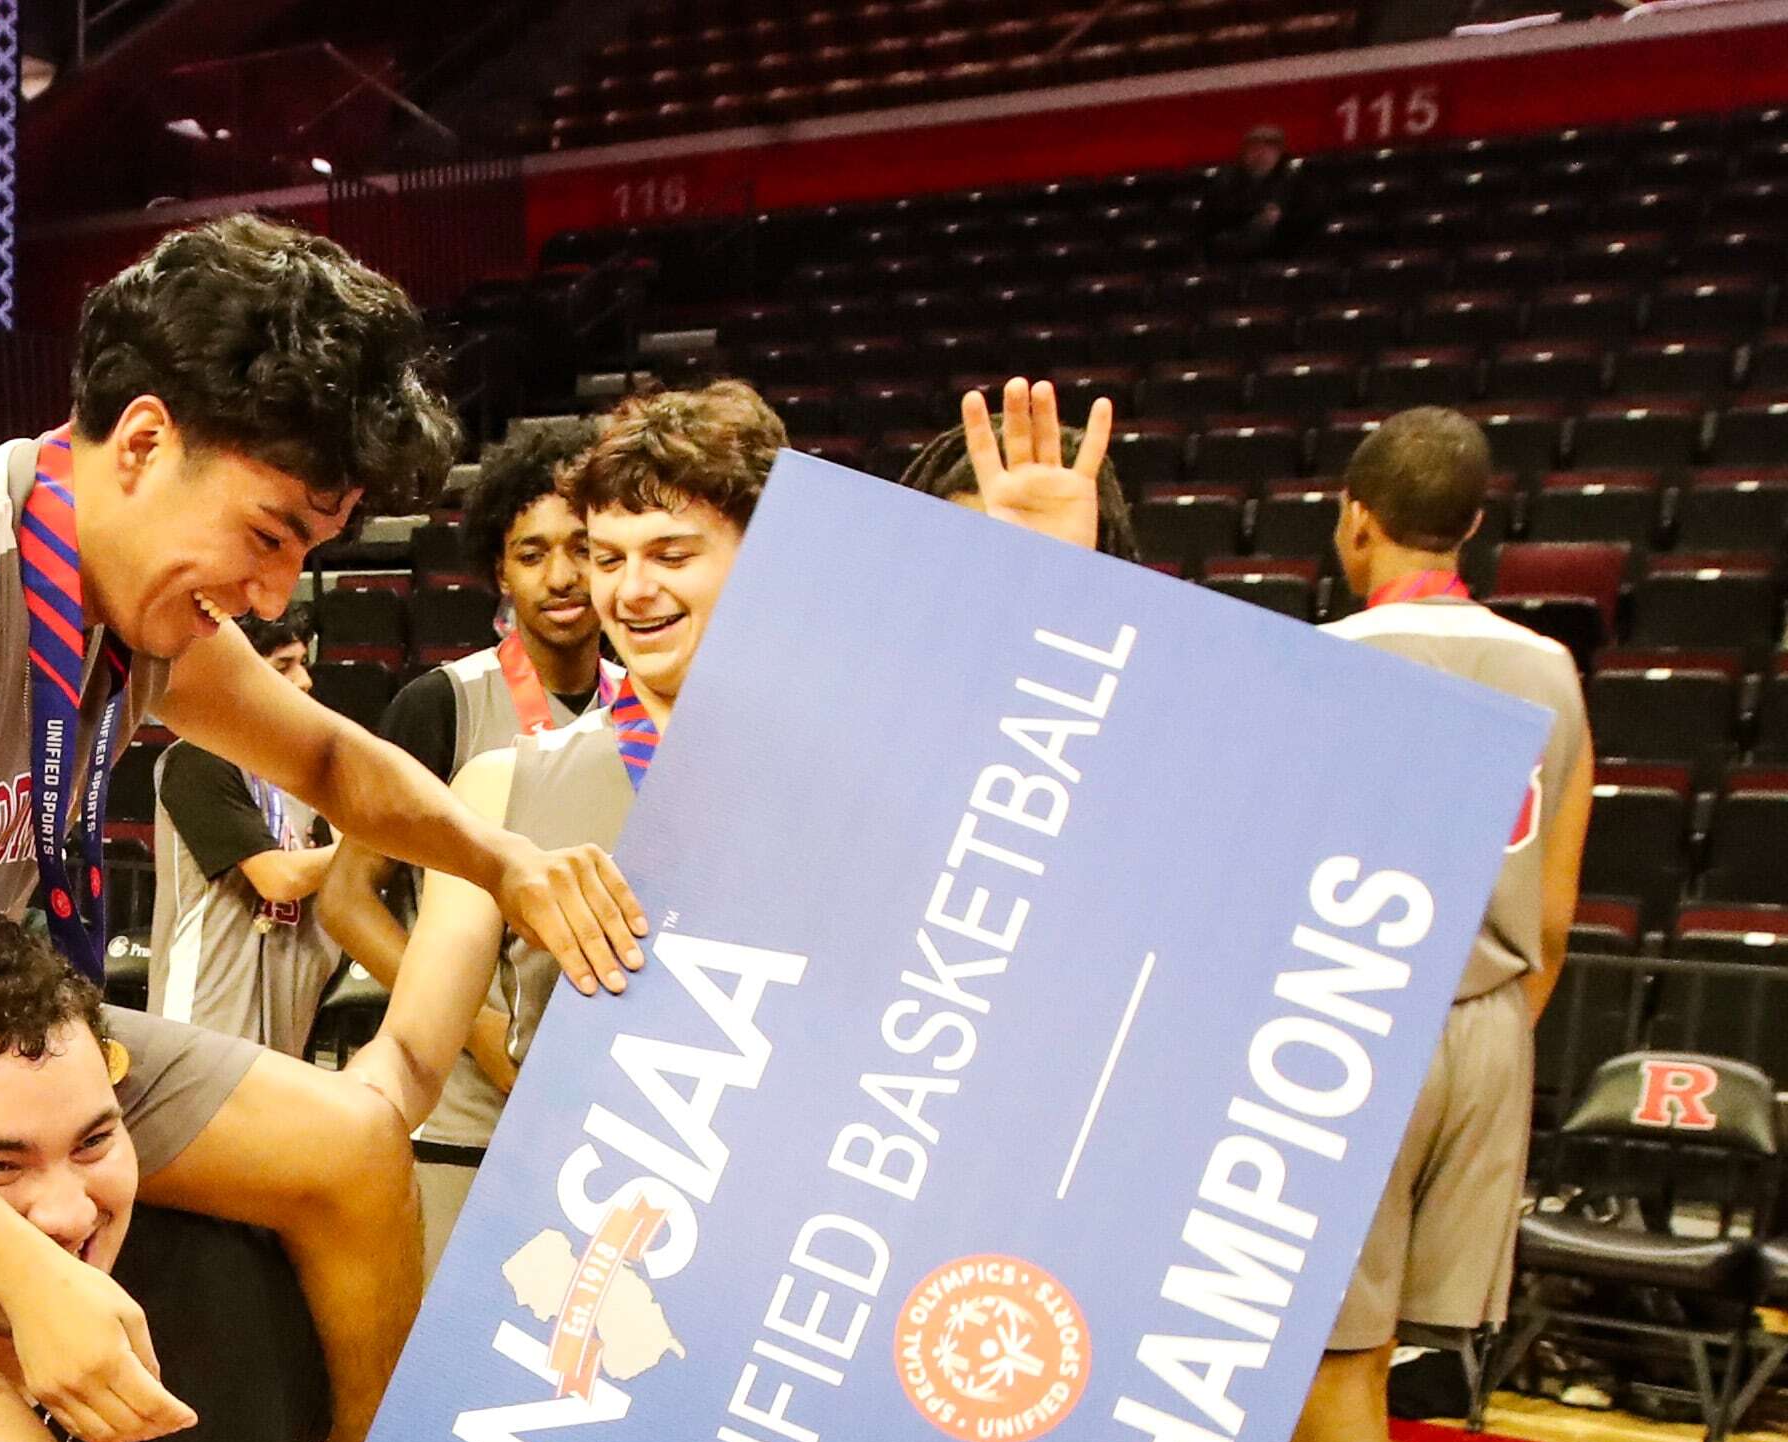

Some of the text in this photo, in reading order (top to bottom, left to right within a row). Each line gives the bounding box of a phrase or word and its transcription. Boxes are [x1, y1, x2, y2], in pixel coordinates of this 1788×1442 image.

[1335, 86, 1439, 141] 115
[613, 177, 686, 217] 116
[41, 718, 64, 857] UNIFIED SPORTS
[827, 622, 1139, 1201] BASKETBALL
[1632, 1060, 1718, 1130] R
[577, 1241, 620, 1294] 1918
[902, 1262, 1017, 1424] SPECIAL OLYMPICS
[976, 1281, 1081, 1439] UNIFIED SPORTS
